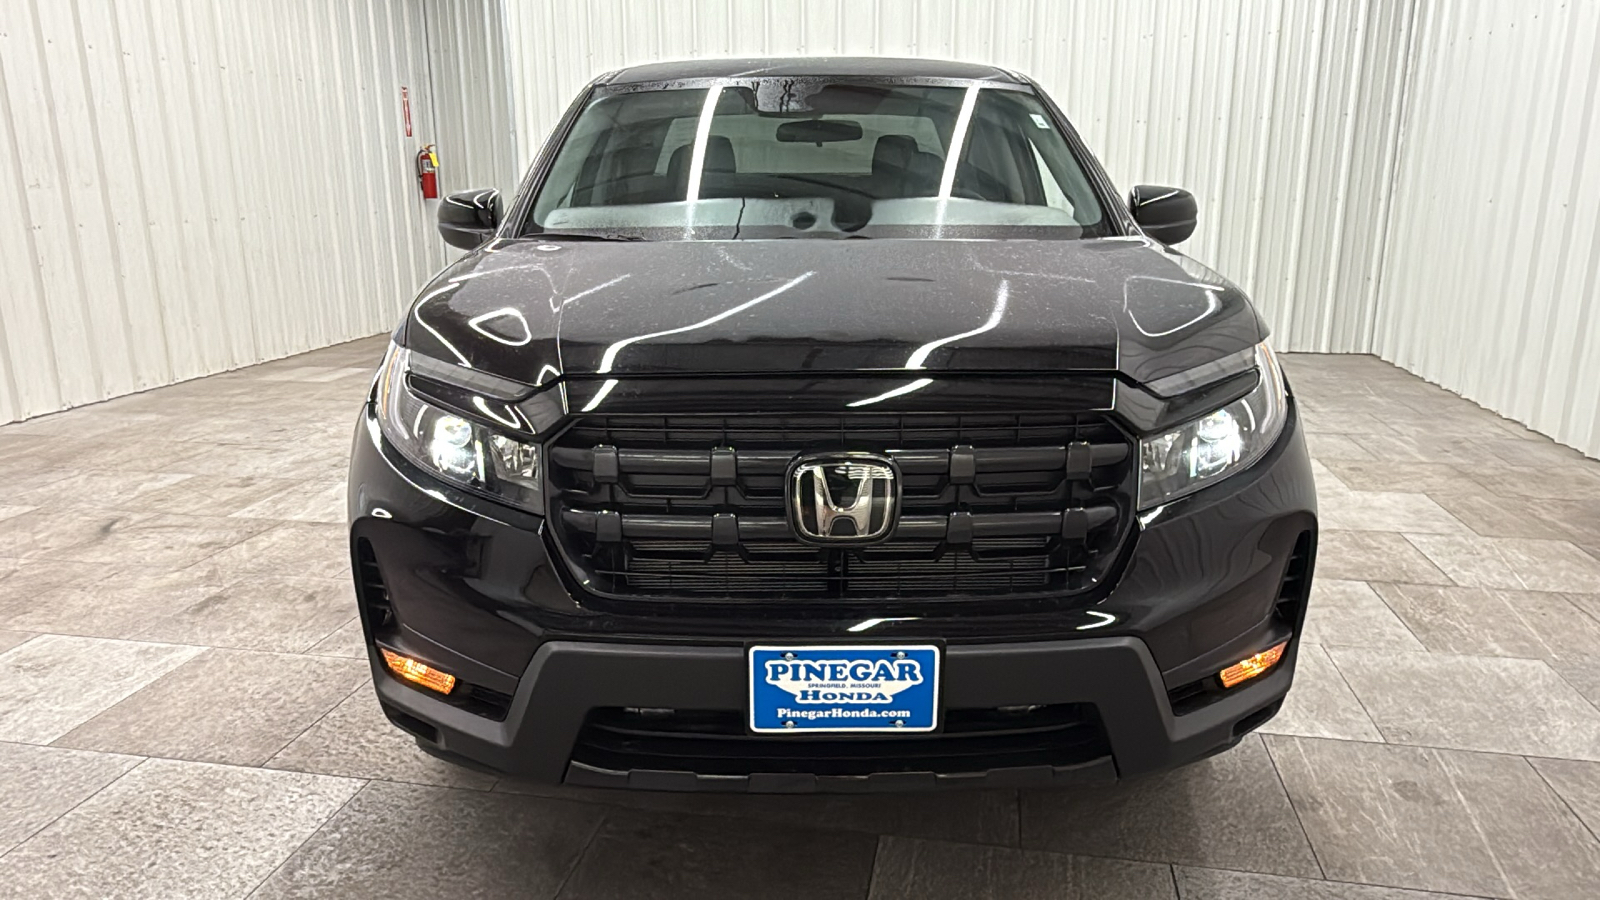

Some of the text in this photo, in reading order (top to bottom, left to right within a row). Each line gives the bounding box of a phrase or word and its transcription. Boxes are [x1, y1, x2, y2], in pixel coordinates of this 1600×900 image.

[769, 663, 919, 682] PINEGAR
[799, 690, 889, 701] HONDA
[777, 708, 911, 720] PinegarHonda.com
